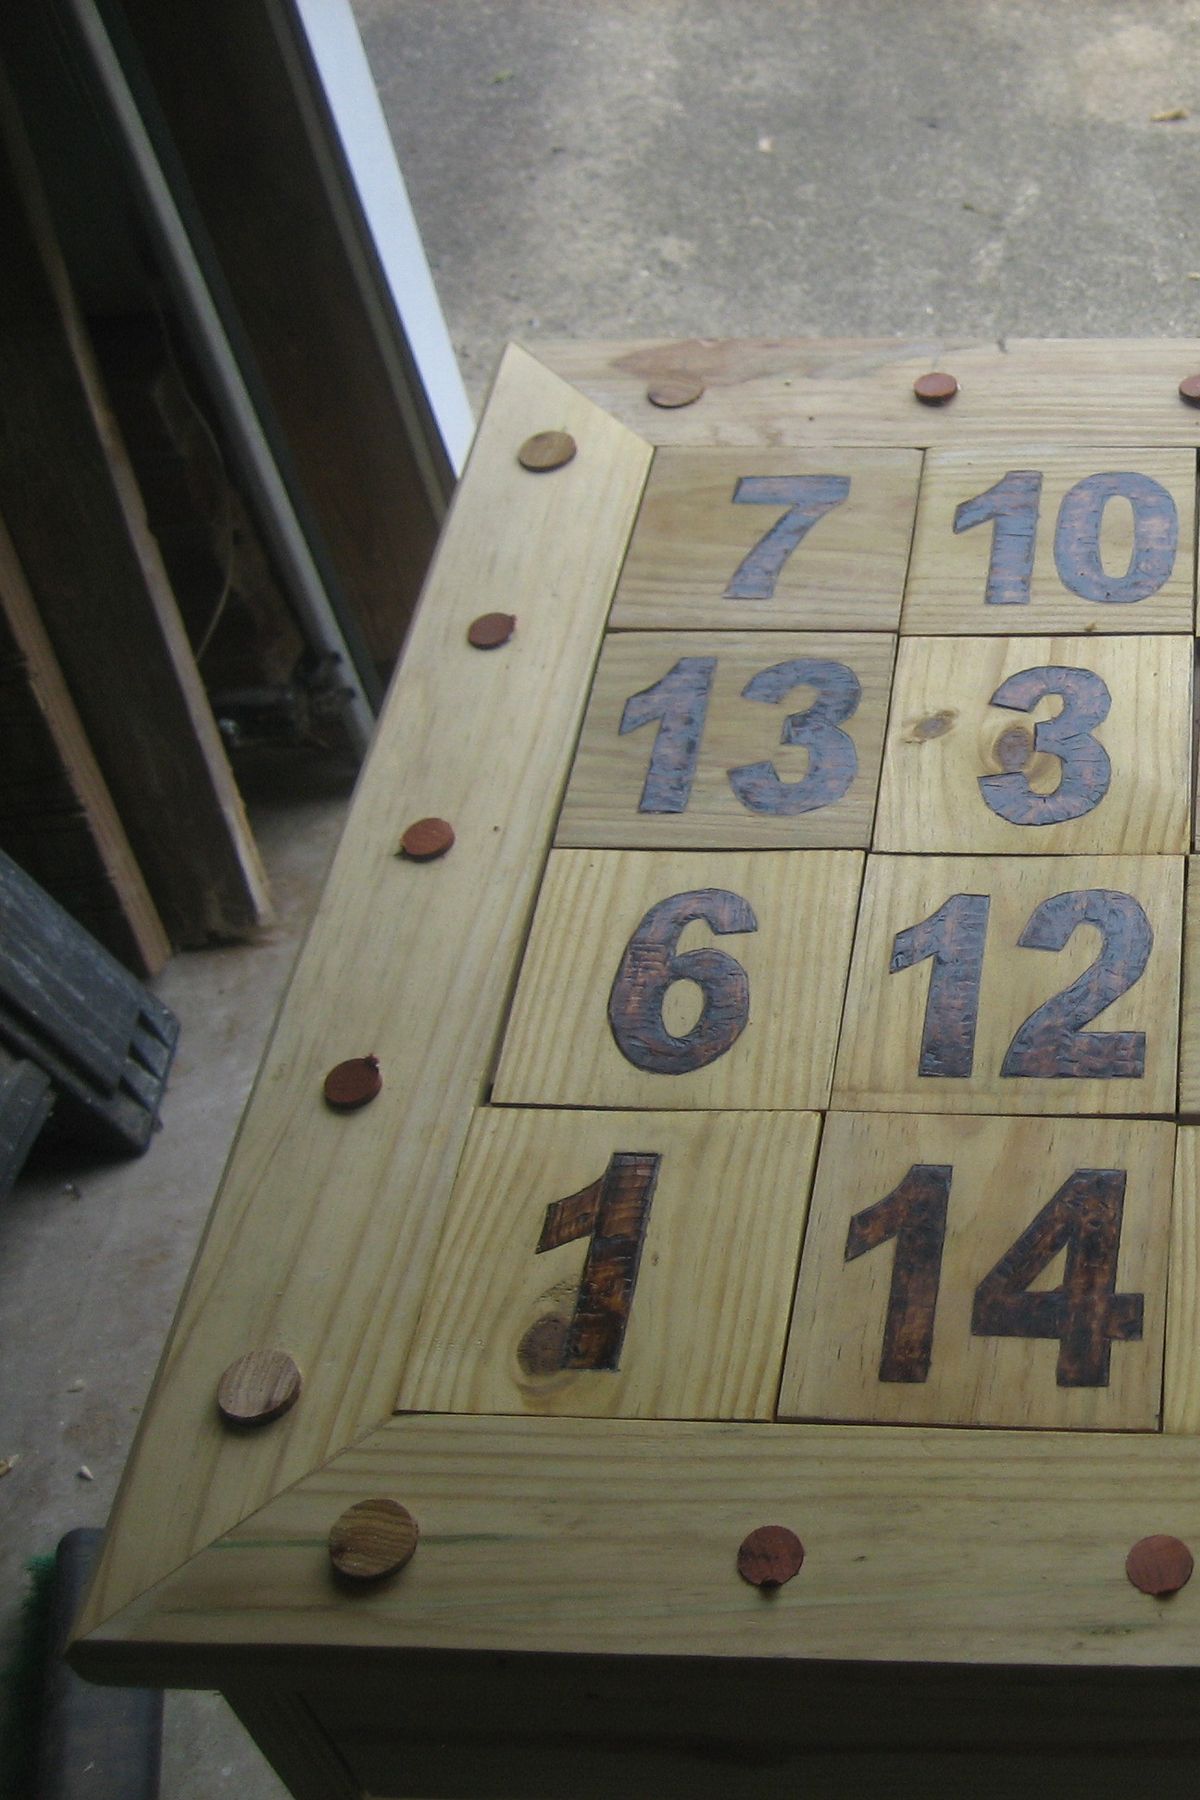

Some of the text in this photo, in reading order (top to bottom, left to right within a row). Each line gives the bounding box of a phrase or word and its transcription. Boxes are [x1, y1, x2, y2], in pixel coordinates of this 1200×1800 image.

[723, 475, 850, 599] 7
[953, 470, 1178, 604] 10
[619, 657, 861, 816] 13
[978, 666, 1111, 826] 3
[607, 888, 757, 1075] 6
[890, 889, 1154, 1078] 12
[536, 1152, 662, 1372] 1
[845, 1164, 1144, 1387] 14
